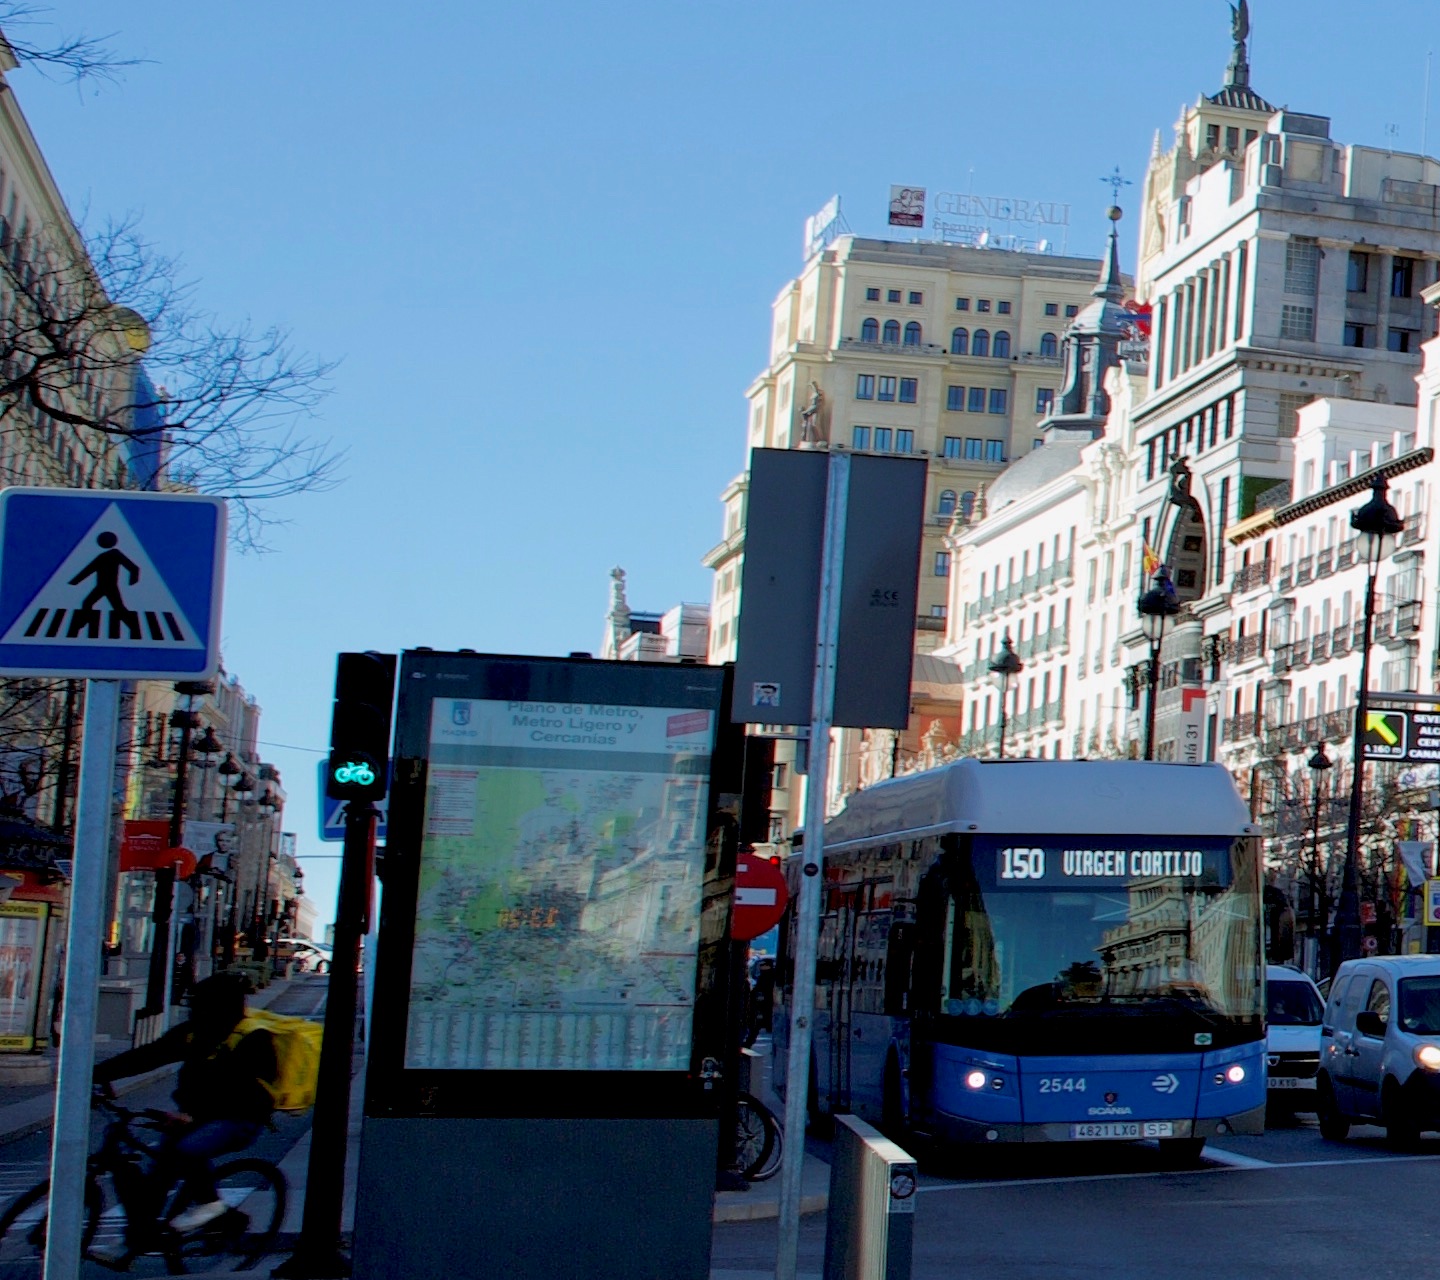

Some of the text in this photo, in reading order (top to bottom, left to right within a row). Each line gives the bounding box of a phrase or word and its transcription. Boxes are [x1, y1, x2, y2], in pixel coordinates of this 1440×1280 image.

[935, 191, 1072, 226] GENERALI
[562, 700, 583, 715] de
[588, 703, 644, 719] Metro,
[512, 715, 638, 733] Metro Ligero y
[1186, 724, 1198, 739] 31
[442, 729, 478, 737] MADRID
[530, 730, 617, 745] Cercanías
[1001, 848, 1203, 879] 150 VIRGEN CORTIJO
[1039, 1078, 1087, 1093] 2544
[1087, 1107, 1133, 1116] SCANIA
[1078, 1124, 1137, 1136] 4821 LXG
[1149, 1124, 1169, 1135] SP
